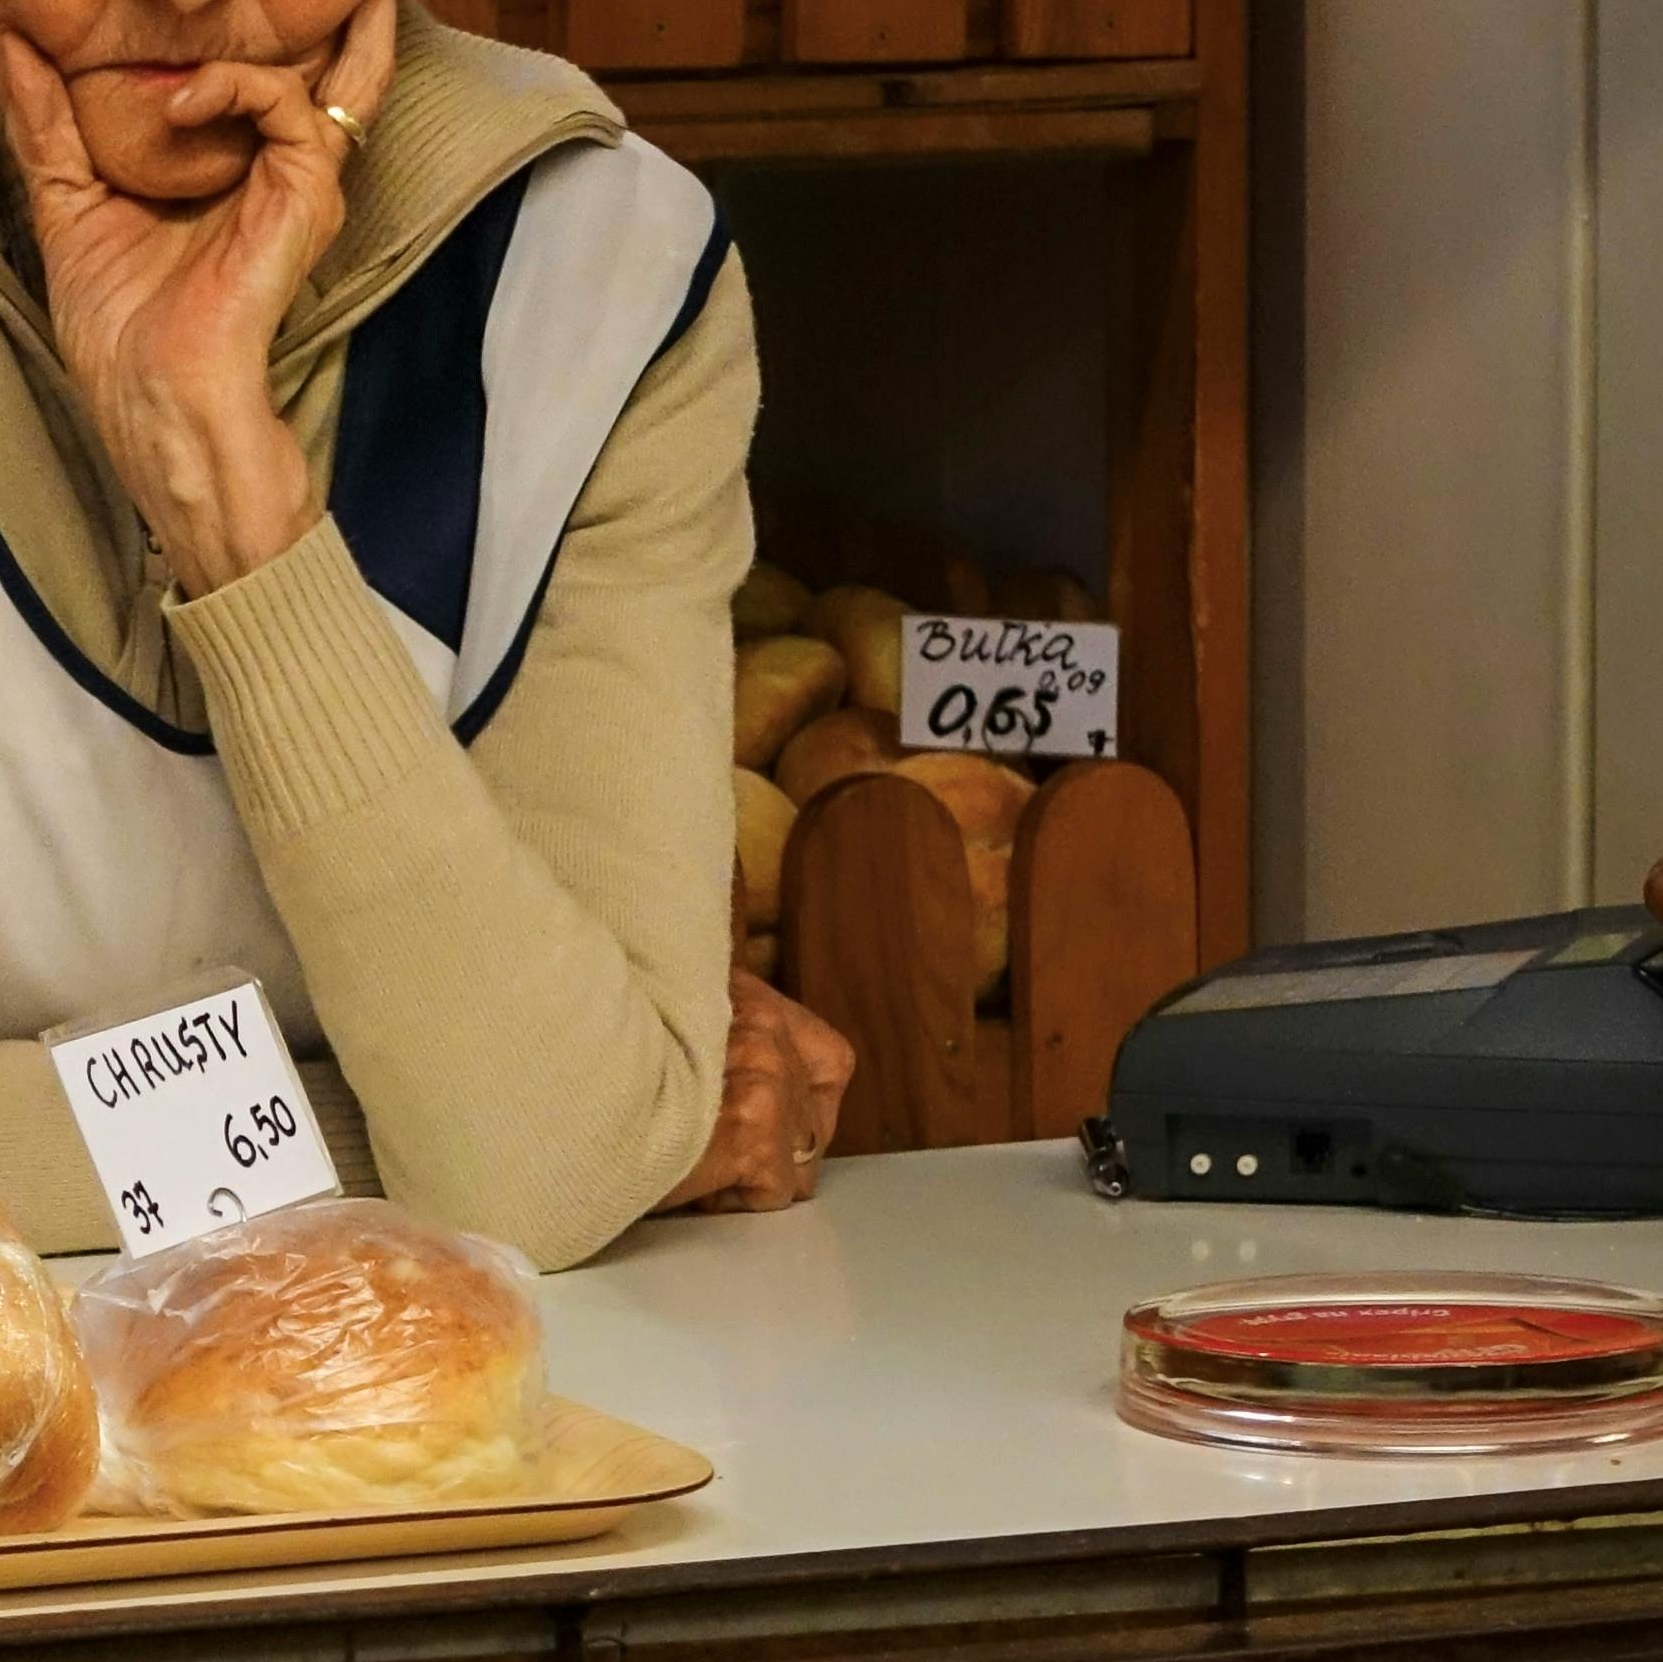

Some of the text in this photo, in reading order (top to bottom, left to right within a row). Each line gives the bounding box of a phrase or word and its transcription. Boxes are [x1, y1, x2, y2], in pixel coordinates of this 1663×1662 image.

[86, 999, 248, 1109] CHRUSTY
[223, 1095, 298, 1169] 6,50
[121, 1180, 165, 1235] 37
